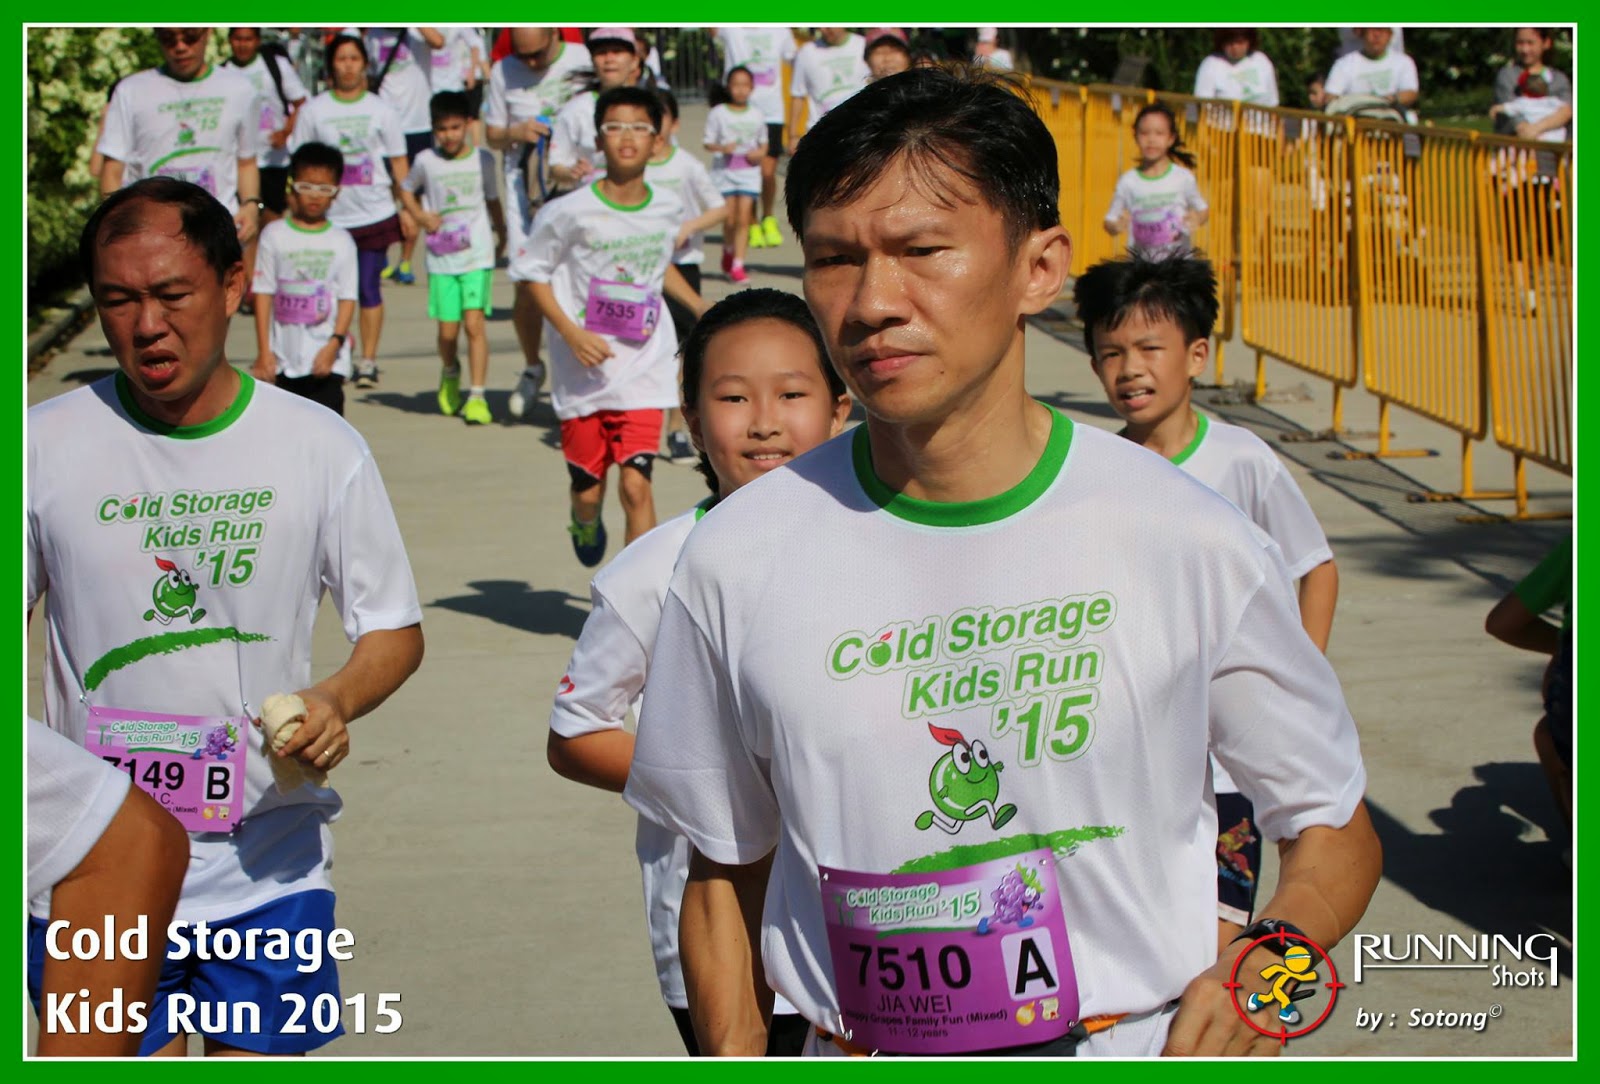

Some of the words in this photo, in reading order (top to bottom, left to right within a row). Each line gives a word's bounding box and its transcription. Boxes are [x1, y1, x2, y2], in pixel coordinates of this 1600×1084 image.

[596, 300, 636, 319] 7535
[646, 310, 655, 325] A
[98, 494, 164, 522] Cold
[169, 488, 274, 517] Storage
[143, 524, 202, 549] Kids
[208, 518, 264, 543] Run
[196, 547, 257, 586] '15
[830, 621, 937, 675] Cold
[948, 596, 1113, 655] Storage
[907, 659, 1000, 713] Kids
[1013, 649, 1099, 693] Run
[110, 721, 135, 732] Cold
[136, 721, 178, 733] Storage
[125, 733, 150, 743] Kids
[151, 733, 173, 743] Run
[995, 693, 1094, 762] '15
[206, 765, 231, 801] B
[847, 887, 877, 907] Cold
[879, 883, 937, 903] Storage
[870, 906, 902, 922] Kids
[904, 904, 936, 919] Run
[848, 942, 972, 991] 7510
[1013, 937, 1058, 996] A
[877, 995, 905, 1013] JIA
[908, 994, 953, 1014] WEI
[869, 1013, 903, 1026] Grapes
[905, 1014, 939, 1027] Family
[942, 1014, 963, 1026] Fun
[966, 1009, 1008, 1023] (Mixed)
[907, 1026, 920, 1037] 12
[920, 1027, 949, 1039] years
